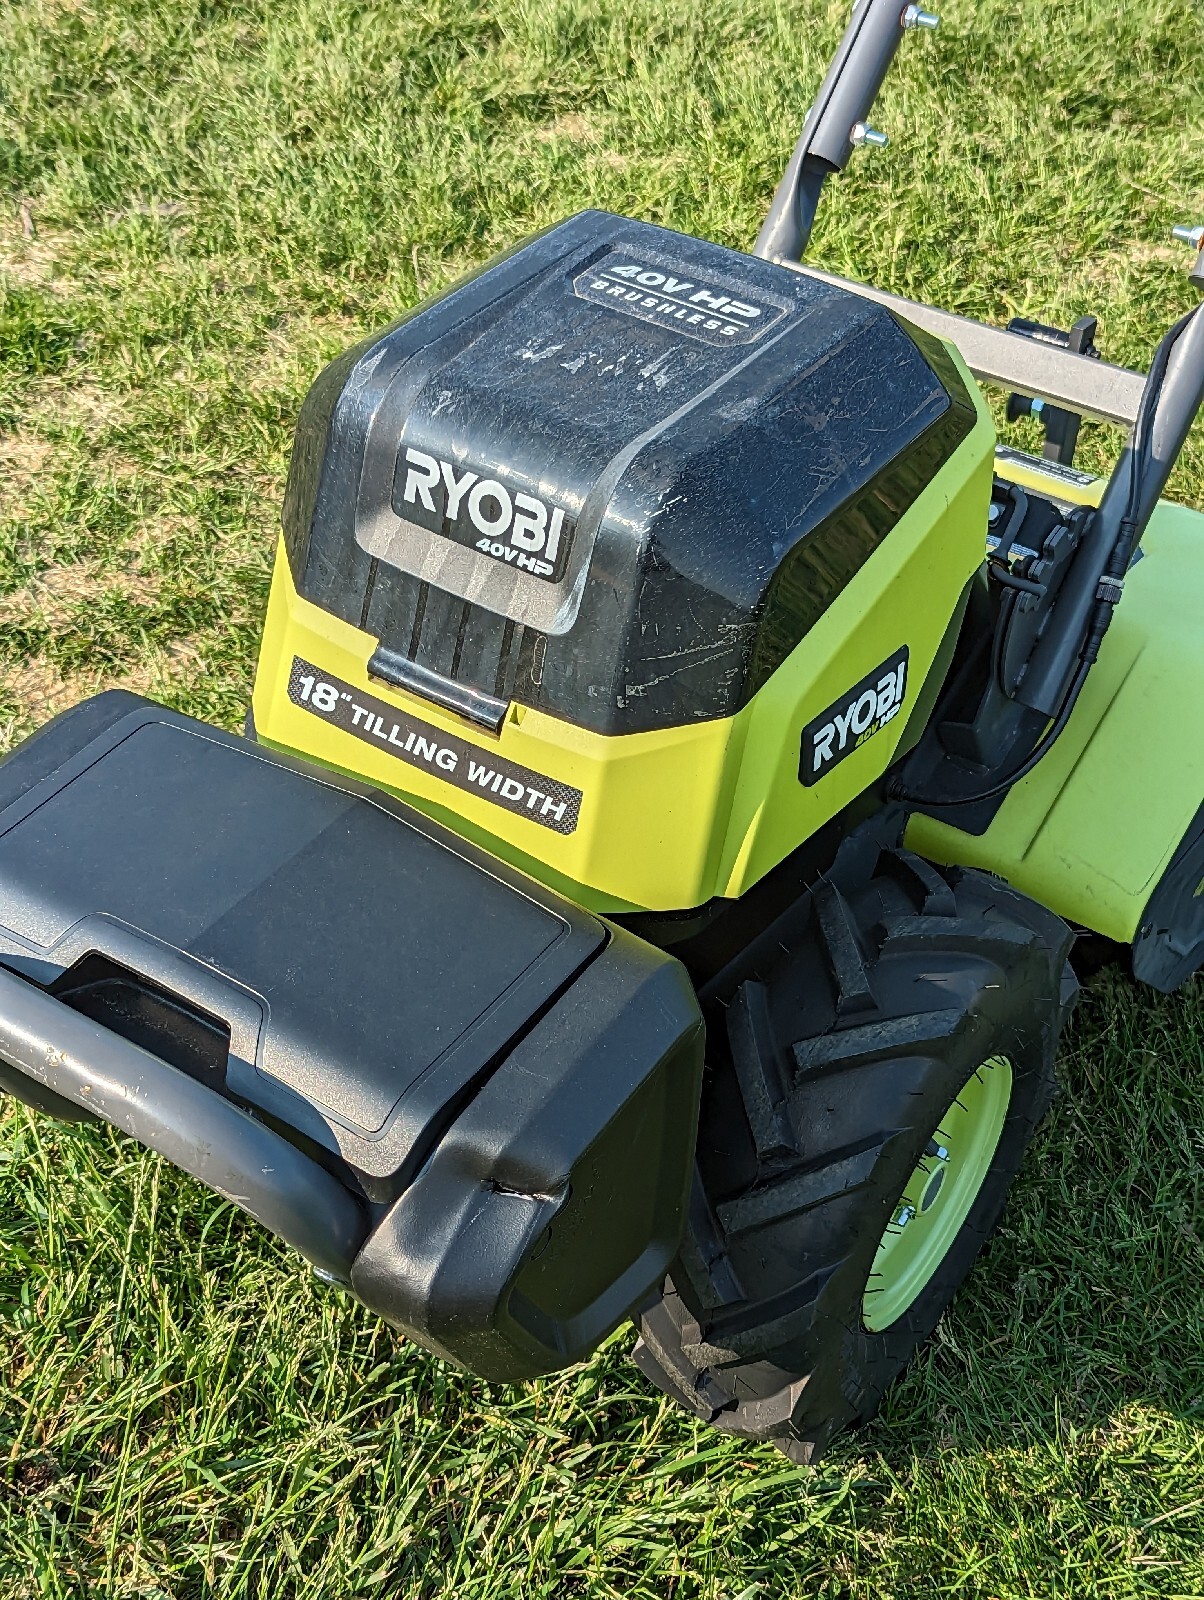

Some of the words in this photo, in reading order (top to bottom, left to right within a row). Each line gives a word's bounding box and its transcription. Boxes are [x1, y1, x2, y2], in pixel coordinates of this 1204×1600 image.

[589, 280, 739, 336] BRUSHLESS
[610, 265, 694, 294] 40V
[688, 290, 761, 318] HP
[403, 447, 566, 562] RYOBI
[351, 703, 459, 773] TILLING
[467, 761, 568, 822] WIDTH
[813, 661, 906, 772] RYOBI
